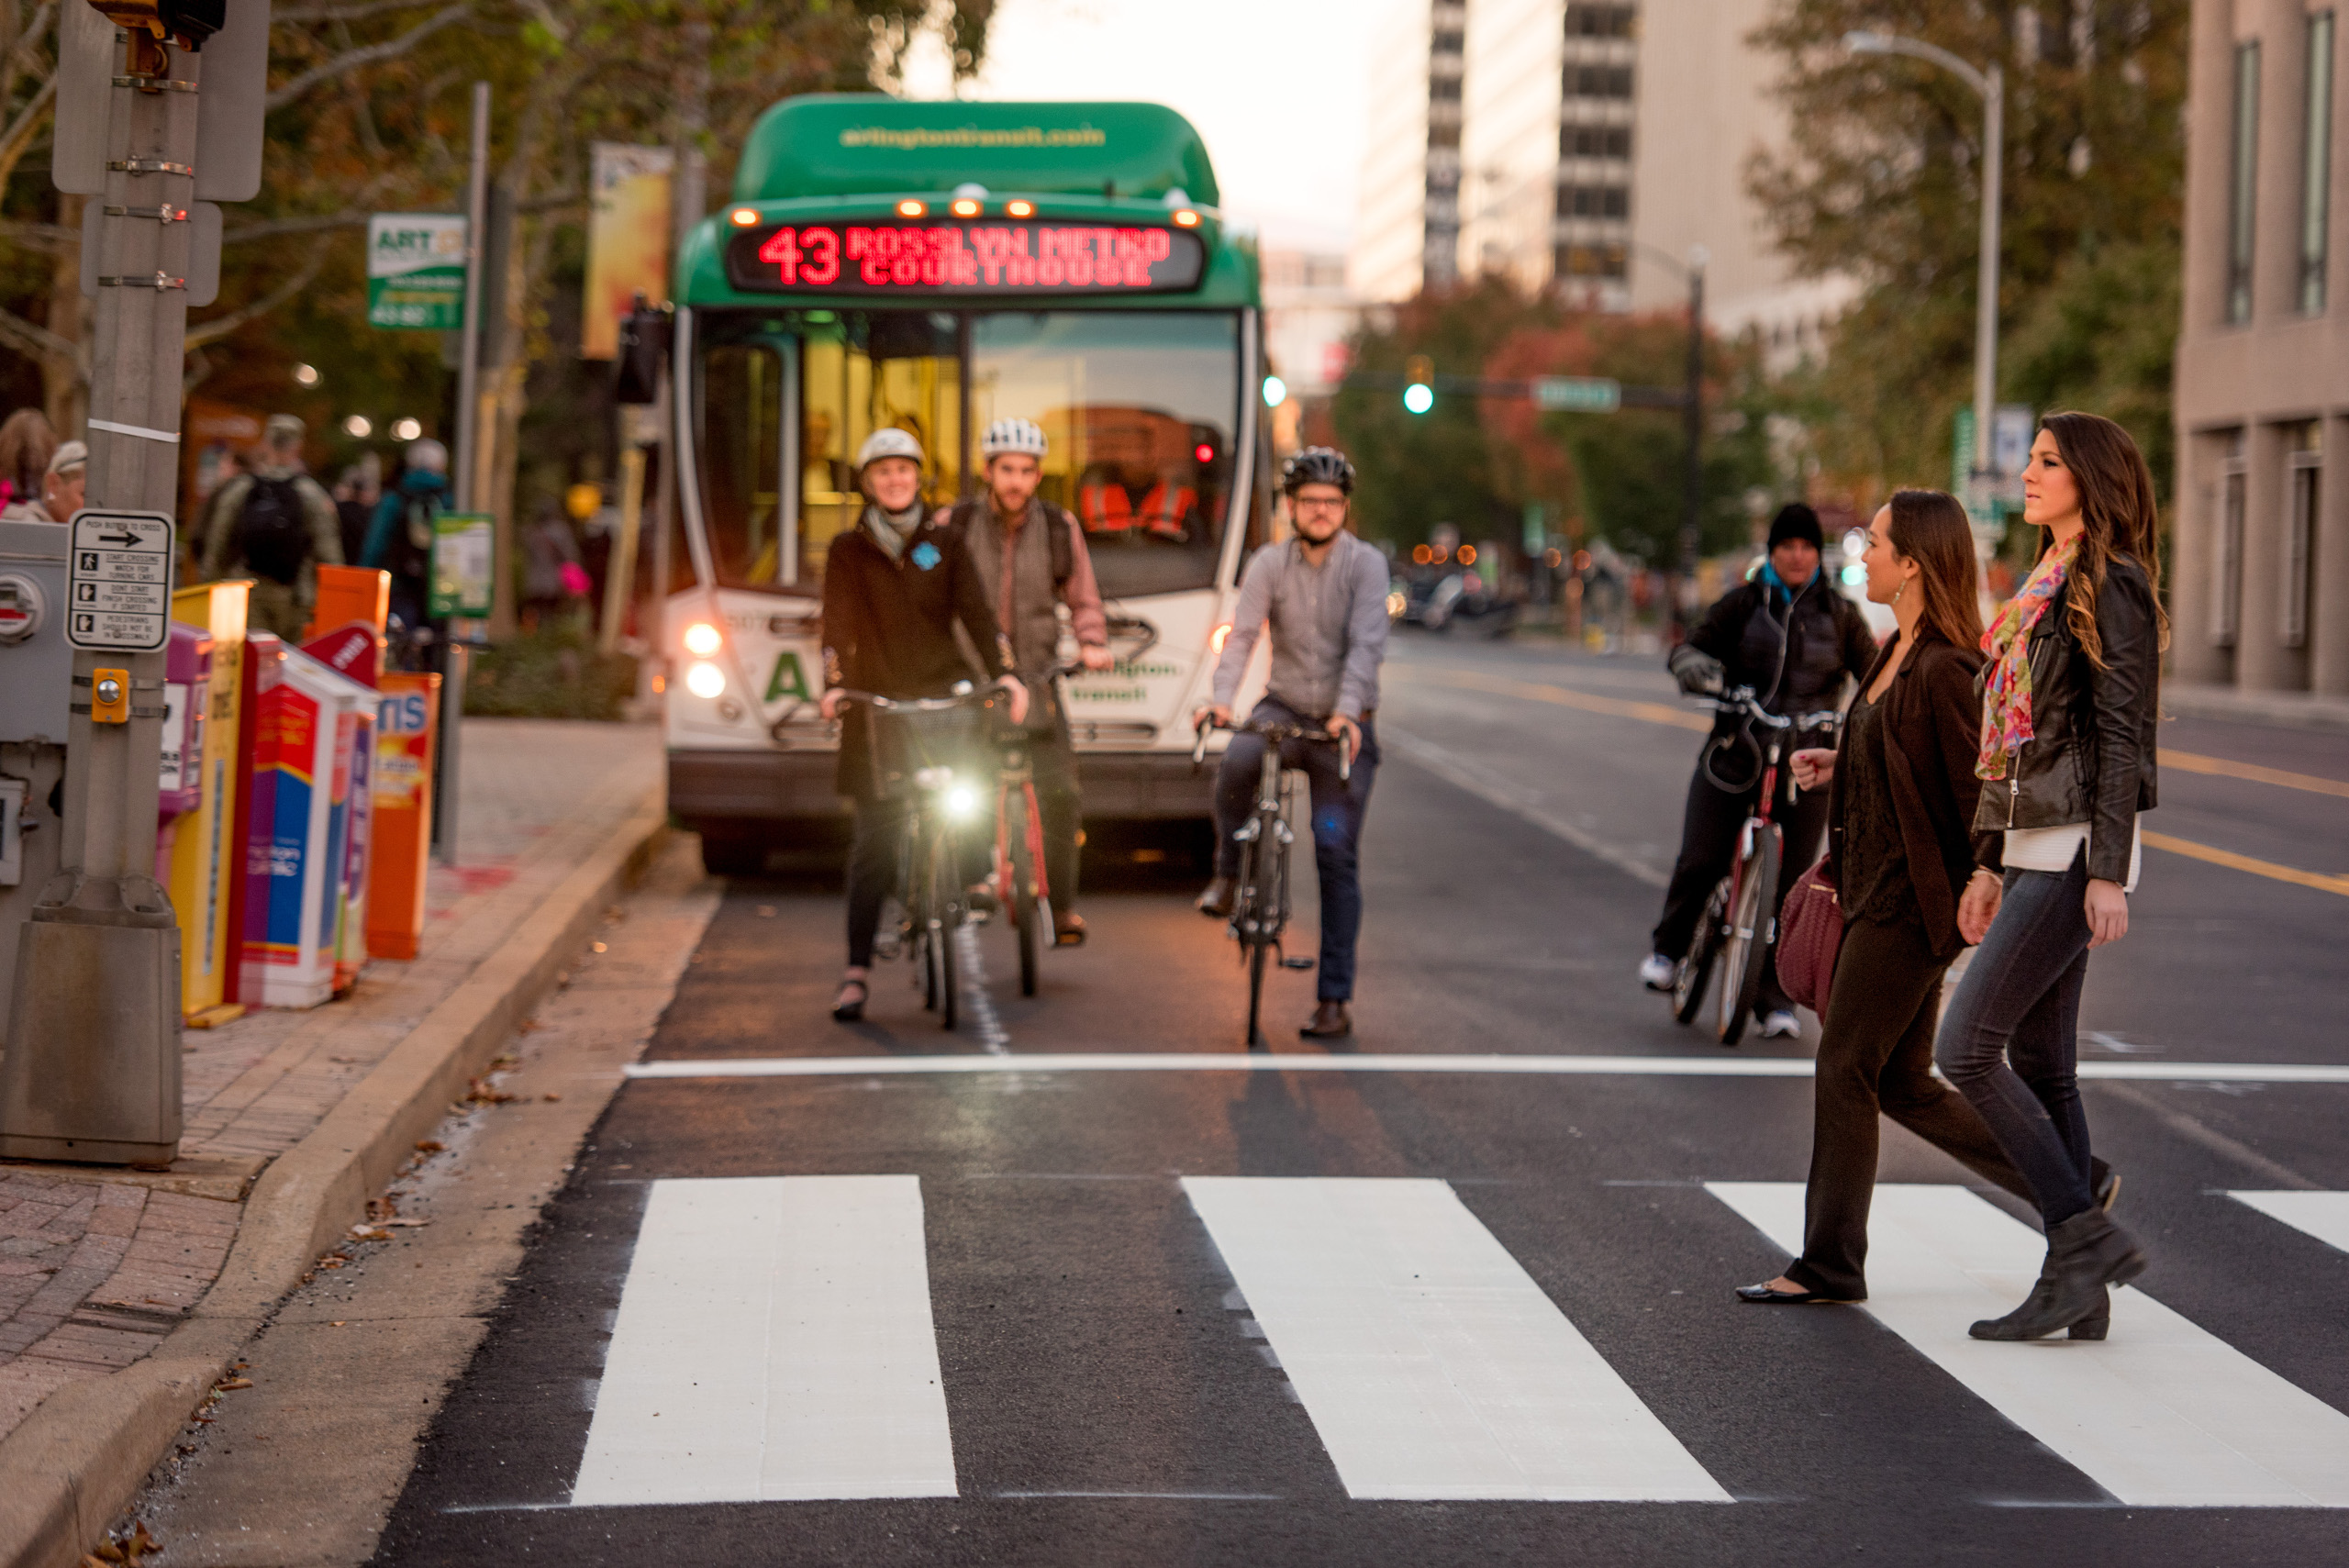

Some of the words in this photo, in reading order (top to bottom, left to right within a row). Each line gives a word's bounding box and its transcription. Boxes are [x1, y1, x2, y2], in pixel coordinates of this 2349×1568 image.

[378, 229, 434, 250] ART
[845, 227, 1030, 264] ROSSLYN
[1038, 227, 1170, 262] METRO
[758, 227, 840, 285] 43
[85, 520, 103, 528] PUSH
[130, 523, 139, 531] TO
[140, 524, 161, 532] CROSS
[106, 553, 125, 562] START
[127, 554, 160, 562] CROSSING
[137, 565, 150, 573] FOR
[109, 572, 136, 580] TURNING
[102, 595, 123, 603] FINISH
[126, 595, 158, 605] CROSSING
[120, 604, 148, 612] STARTED
[106, 615, 150, 624] PEDESTRIANS
[144, 625, 153, 633] BE
